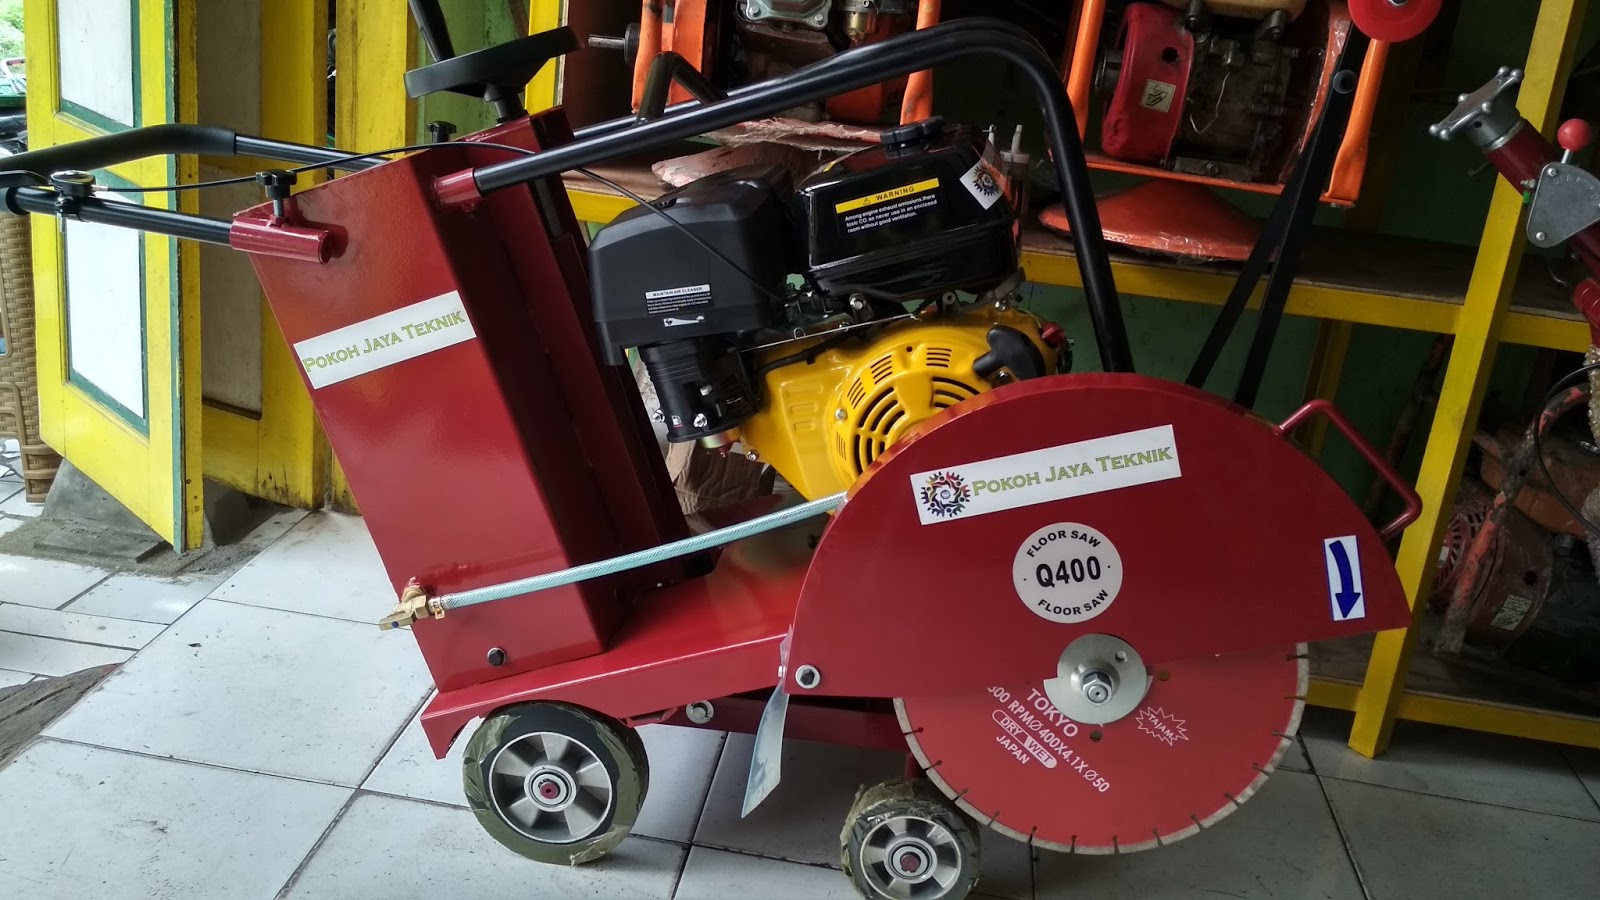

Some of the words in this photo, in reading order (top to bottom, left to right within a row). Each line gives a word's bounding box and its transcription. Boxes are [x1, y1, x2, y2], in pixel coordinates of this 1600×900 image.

[875, 186, 915, 201] WARNING
[846, 219, 859, 228] toxic
[876, 212, 890, 220] never
[914, 200, 938, 210] enclosed
[860, 221, 878, 230] without
[878, 218, 891, 226] good
[862, 209, 878, 217] engine
[879, 204, 897, 213] exhaust
[302, 345, 361, 372] POKOH
[363, 332, 403, 354] JAYA
[401, 310, 466, 340] TEKNIK
[971, 471, 1041, 496] POKOH
[1045, 462, 1094, 483] JAYA
[1095, 446, 1173, 472] TEKNIK
[1026, 530, 1067, 558] FLOOR
[1070, 530, 1101, 548] SAW
[1035, 555, 1101, 588] Q400
[1037, 598, 1082, 616] FLOOR
[1083, 589, 1109, 612] SAW
[1026, 688, 1078, 737] TOKYO
[1148, 713, 1174, 739] TAJAM
[995, 735, 1031, 765] JAPAN
[999, 716, 1023, 736] DRY
[1028, 740, 1053, 763] WET
